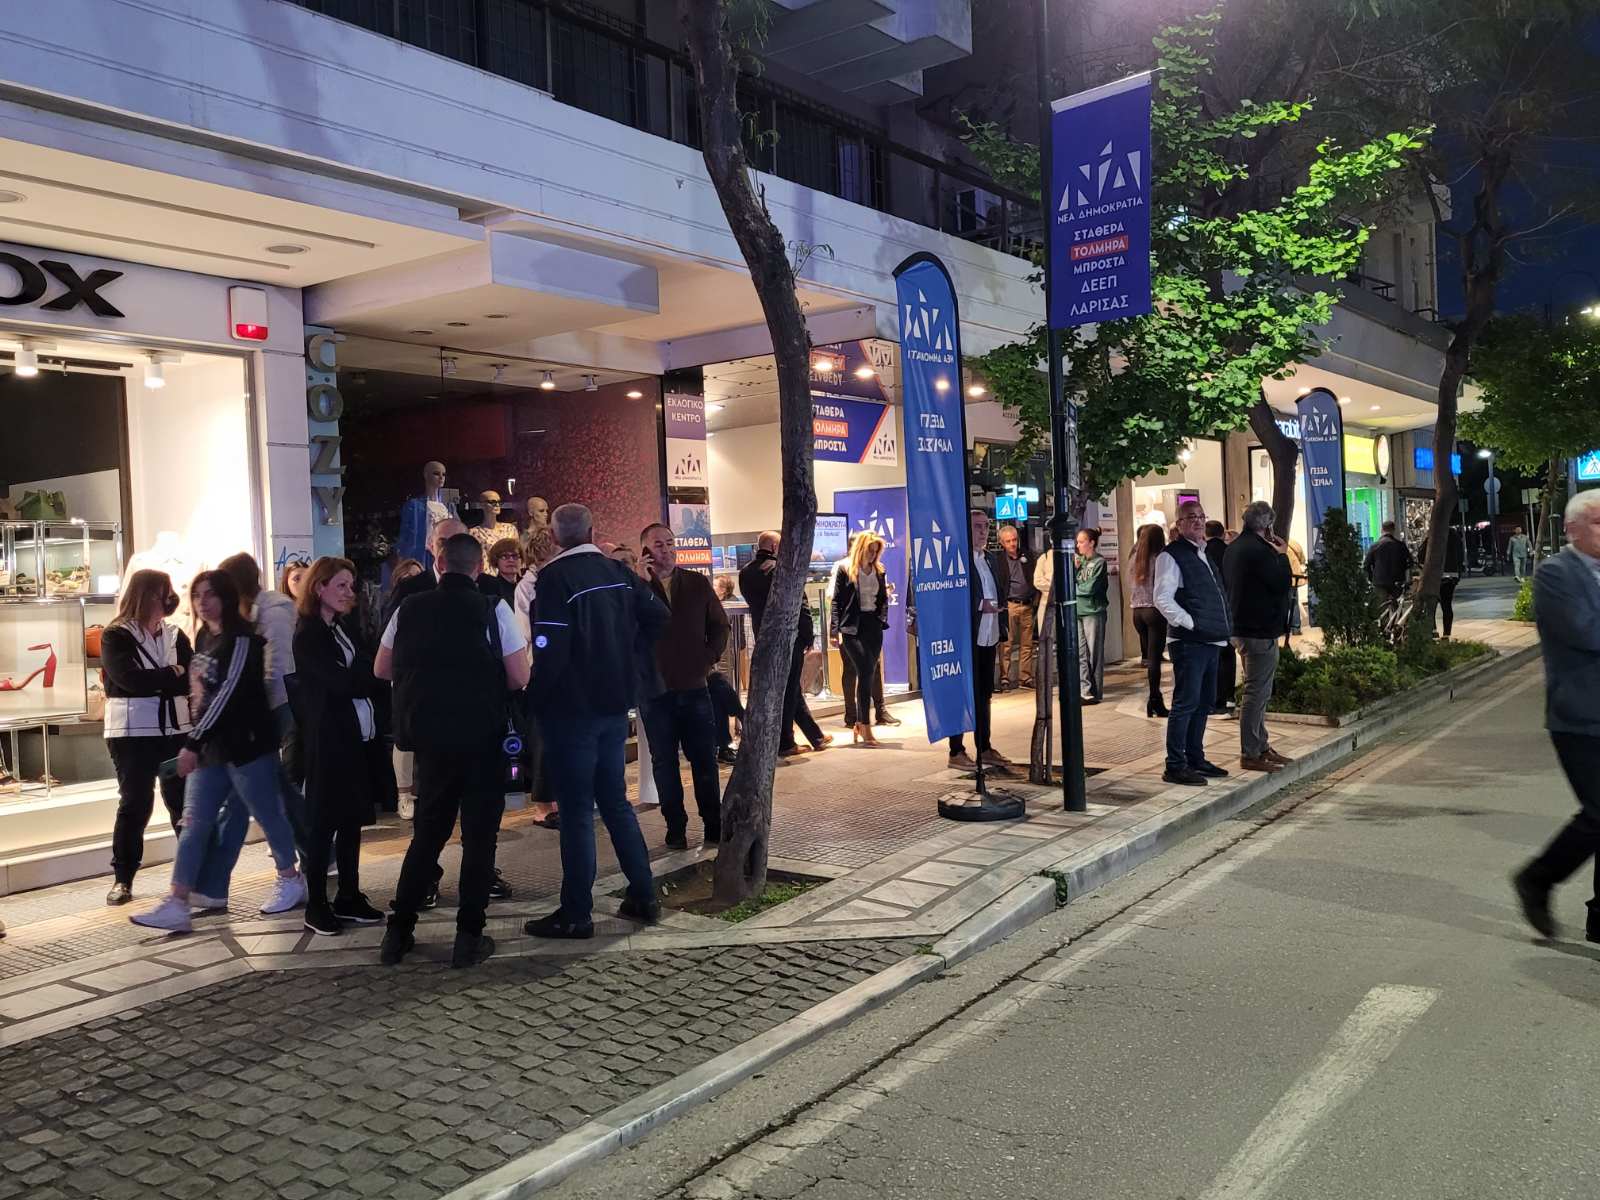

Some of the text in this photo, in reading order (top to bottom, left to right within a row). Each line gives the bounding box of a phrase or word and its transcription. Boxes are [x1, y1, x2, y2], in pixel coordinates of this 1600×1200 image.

[1057, 197, 1144, 224] ΝΕΑ ΔΗΜΟΚΡΑΤΙΑ
[1074, 222, 1125, 241] ΣΤΑΘΕΡΑ
[1074, 239, 1126, 257] ΤΟΛΜΗΡΑ
[1073, 255, 1126, 275] ΜΠΡΟΣΤΑ
[1081, 275, 1117, 293] ΔΕΕΠ
[1070, 295, 1129, 316] ΛΑΡΙΣΑΣ
[667, 398, 704, 410] ΕΚΛΟΓΙΚΟ
[671, 412, 701, 423] ΚΕΝΤΡΟ
[305, 334, 347, 525] COZY
[813, 423, 847, 434] ΟΛΜΗΡΑ
[675, 537, 709, 546] ΣΤΑΘΕΡΑ
